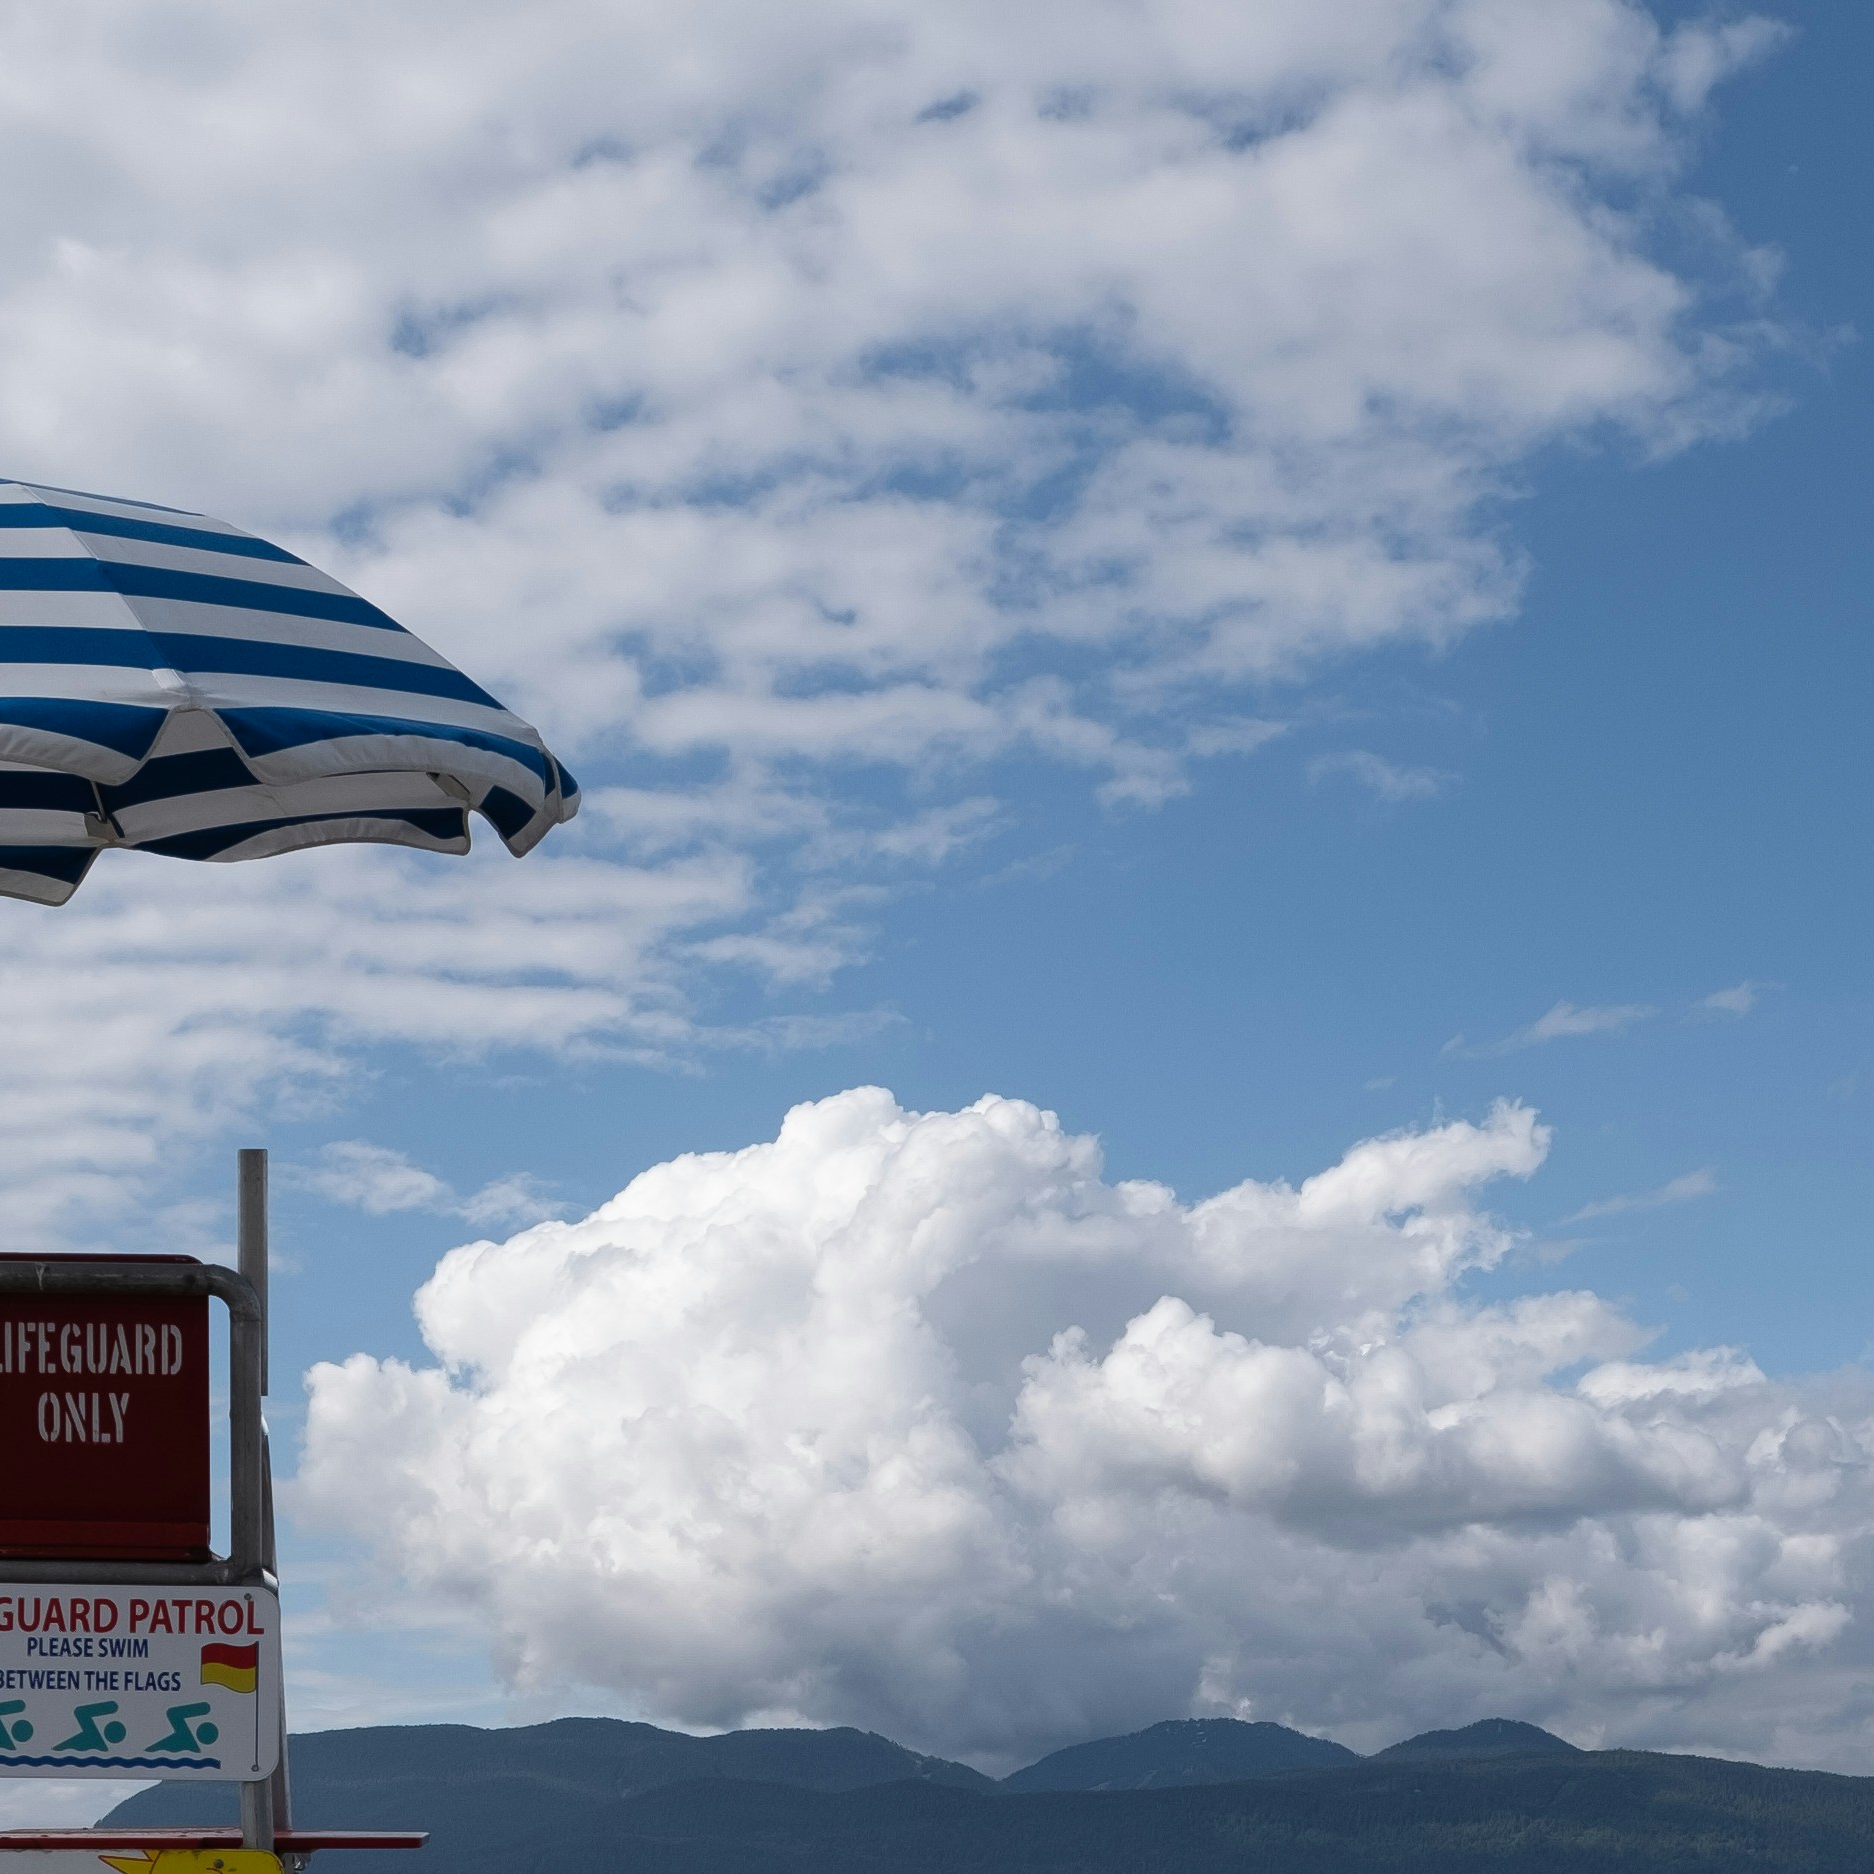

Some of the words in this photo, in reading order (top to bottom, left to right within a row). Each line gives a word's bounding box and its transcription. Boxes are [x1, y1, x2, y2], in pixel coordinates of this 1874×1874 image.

[37, 1392, 130, 1444] ONLY
[129, 1599, 265, 1637] PATROL
[26, 1637, 94, 1658] PLEASE
[98, 1638, 149, 1659] SWIM
[84, 1670, 120, 1691] THE
[124, 1671, 182, 1692] FLAGS
